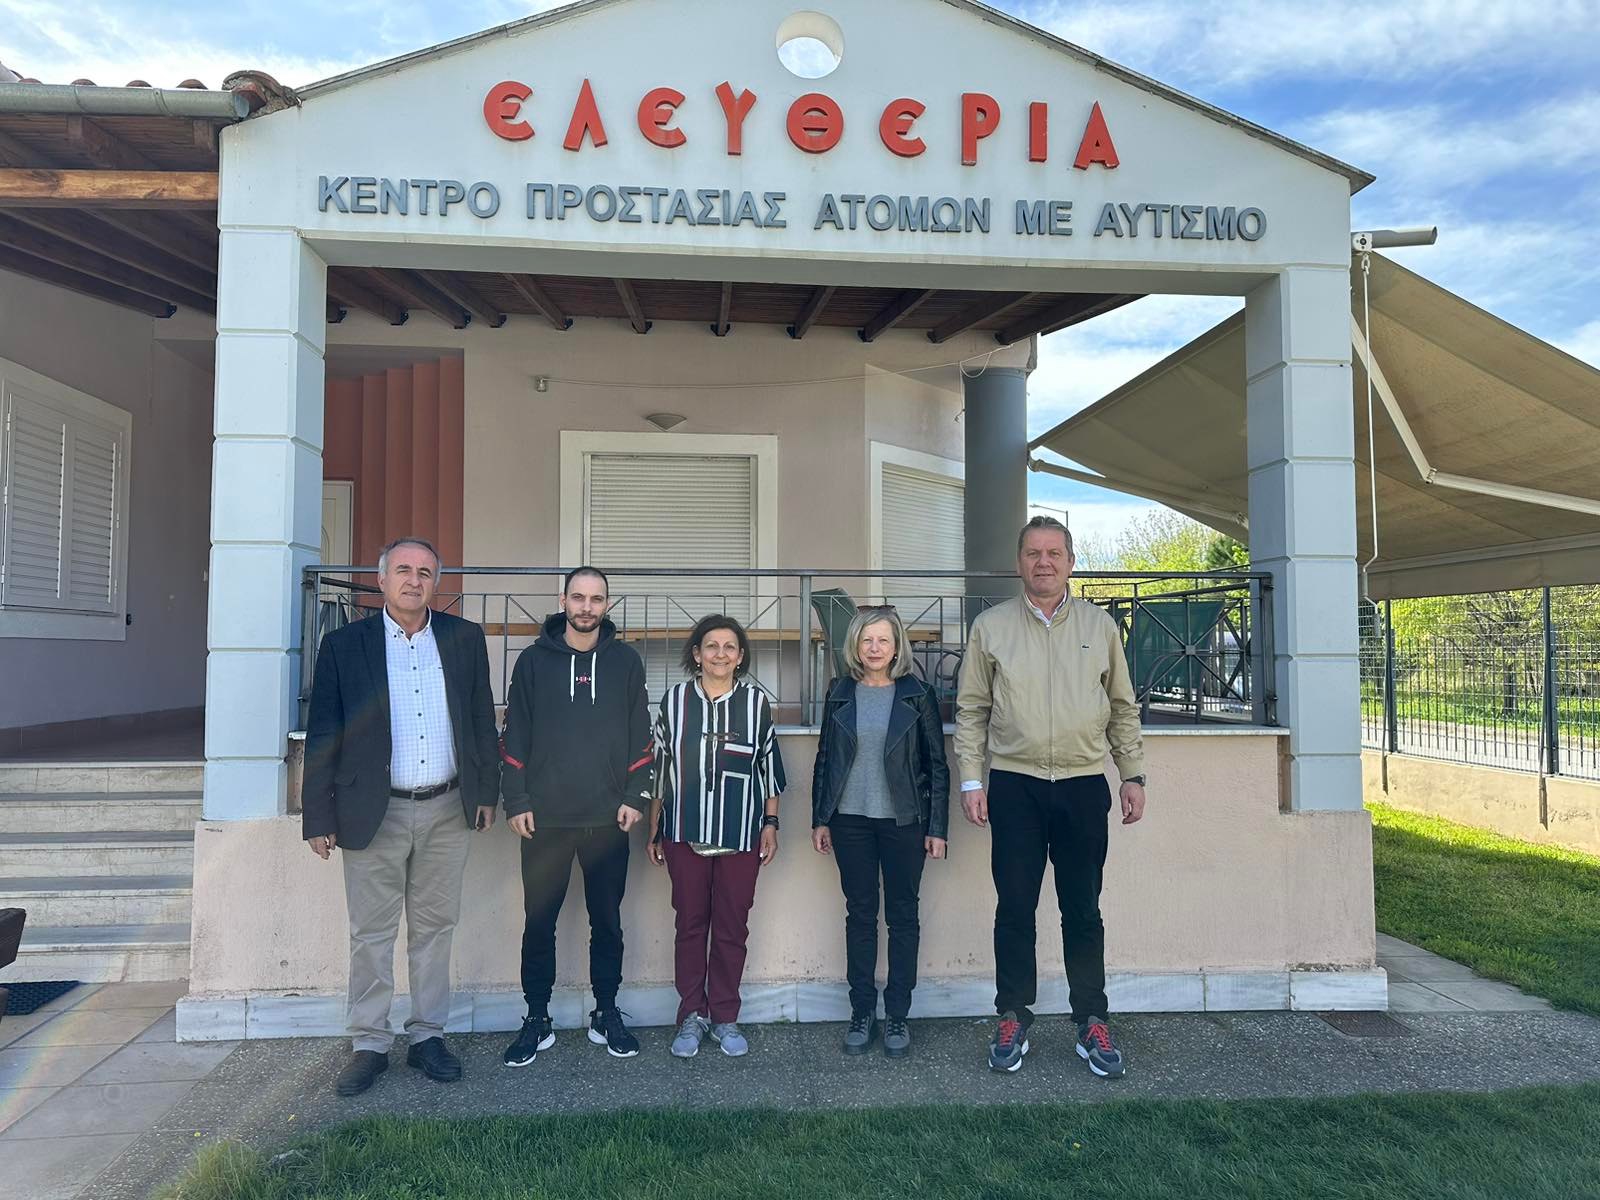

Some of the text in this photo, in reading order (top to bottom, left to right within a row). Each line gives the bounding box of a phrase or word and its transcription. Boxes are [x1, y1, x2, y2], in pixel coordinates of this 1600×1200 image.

[483, 78, 1120, 170] ΕΛΕΥΘΕΡΙΑ
[318, 175, 1268, 242] ΚΕΝΤΡΟ ΠΡΟΣΤΑΣΙΑΣ ΑΤΟΜΩΝ ΜΕ ΑΥΤΙΣΜΟ
